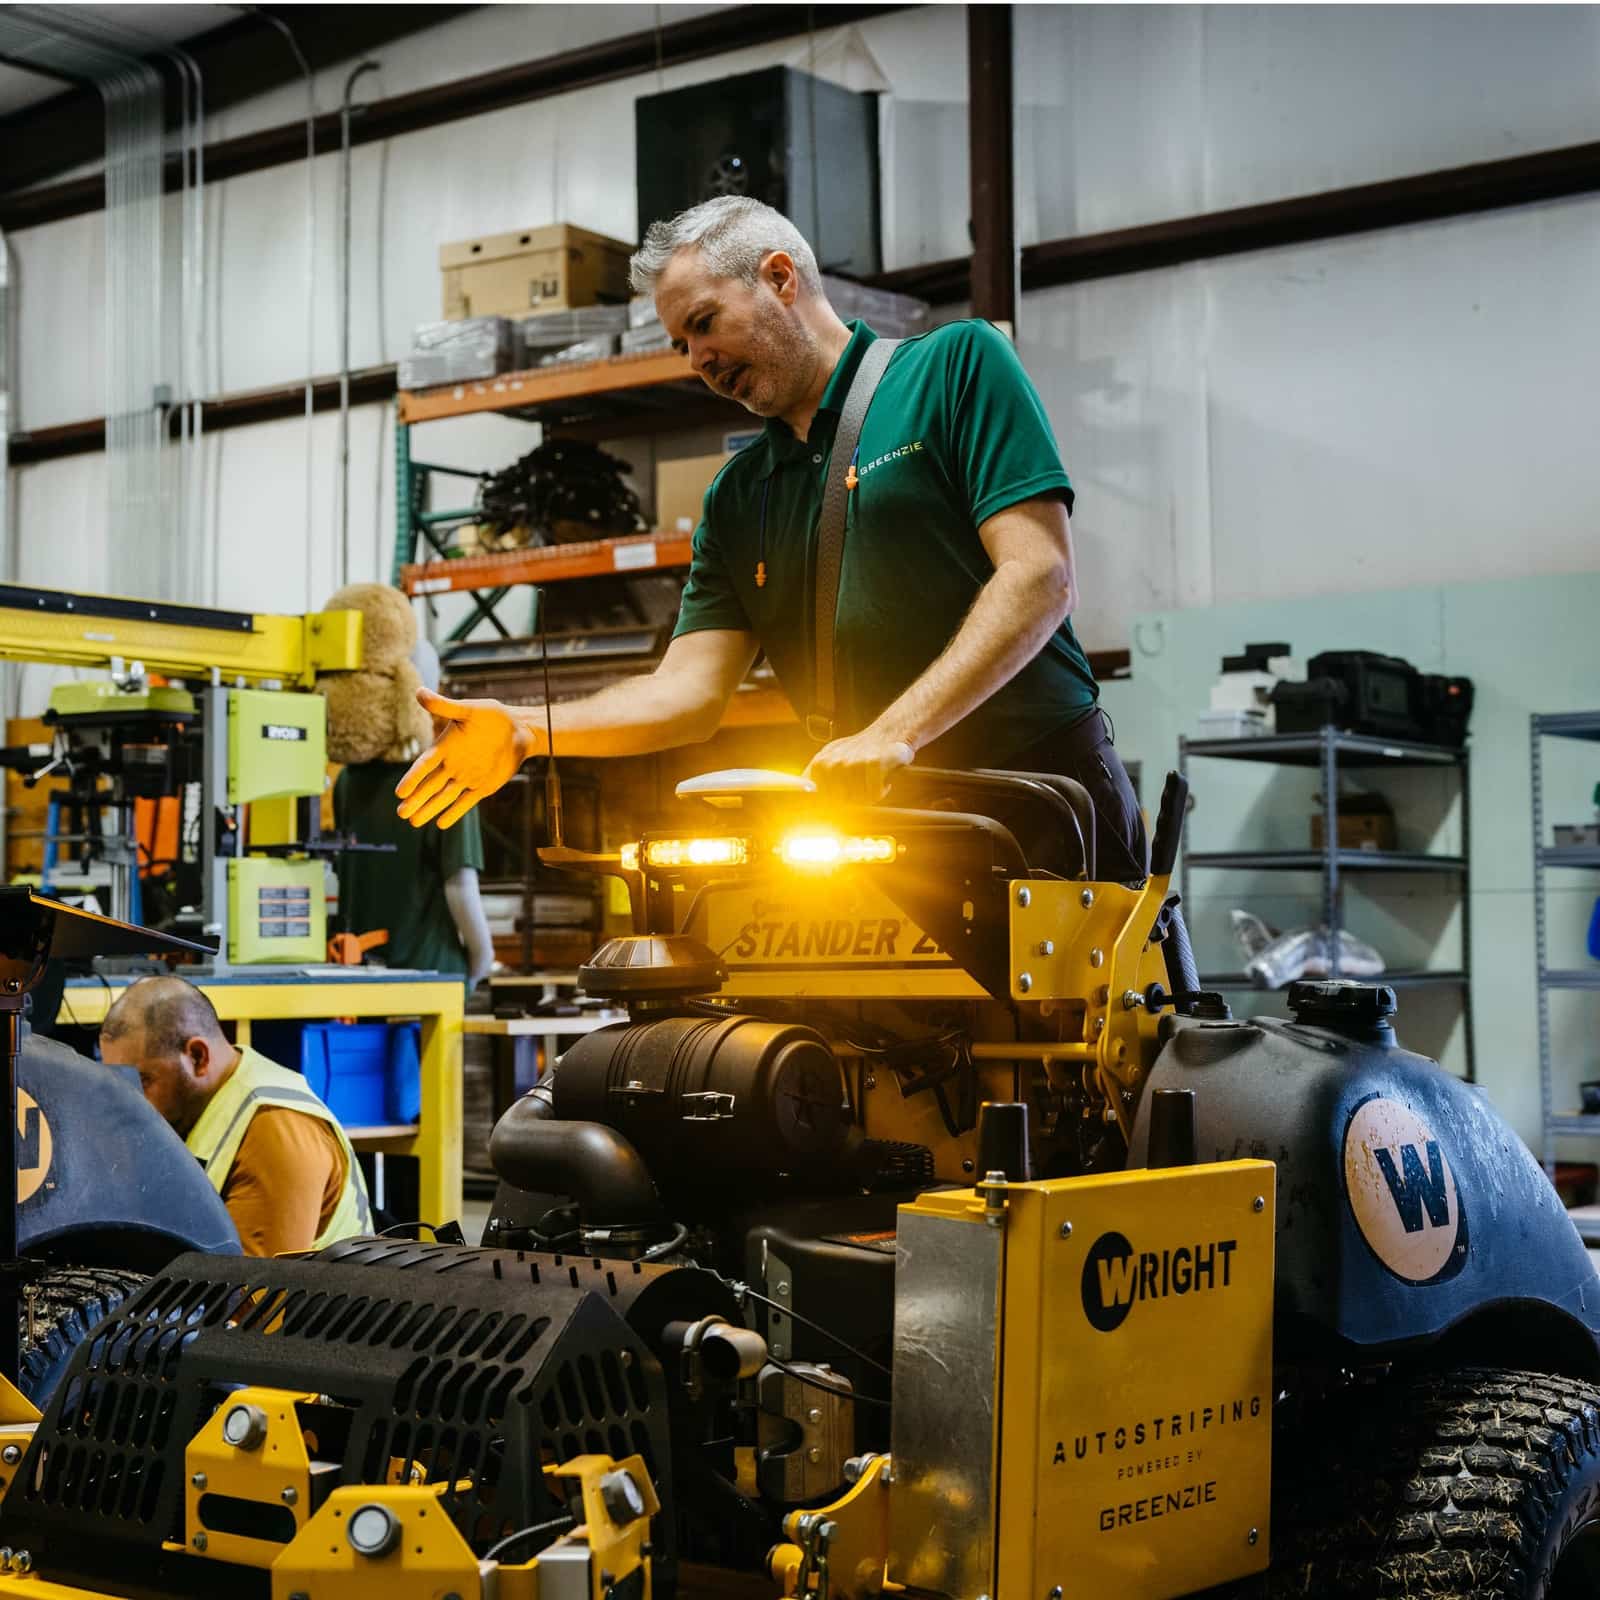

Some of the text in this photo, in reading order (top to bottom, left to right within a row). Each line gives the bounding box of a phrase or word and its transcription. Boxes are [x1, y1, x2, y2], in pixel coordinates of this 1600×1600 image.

[860, 441, 923, 476] GREENZIE
[735, 918, 901, 958] STANDER
[1373, 1141, 1450, 1233] W
[1097, 1239, 1237, 1309] WRIGHT
[1053, 1396, 1261, 1464] AUTOSTRIPING
[1117, 1449, 1203, 1480] POWERED BY
[1099, 1481, 1217, 1532] GREENZIE
